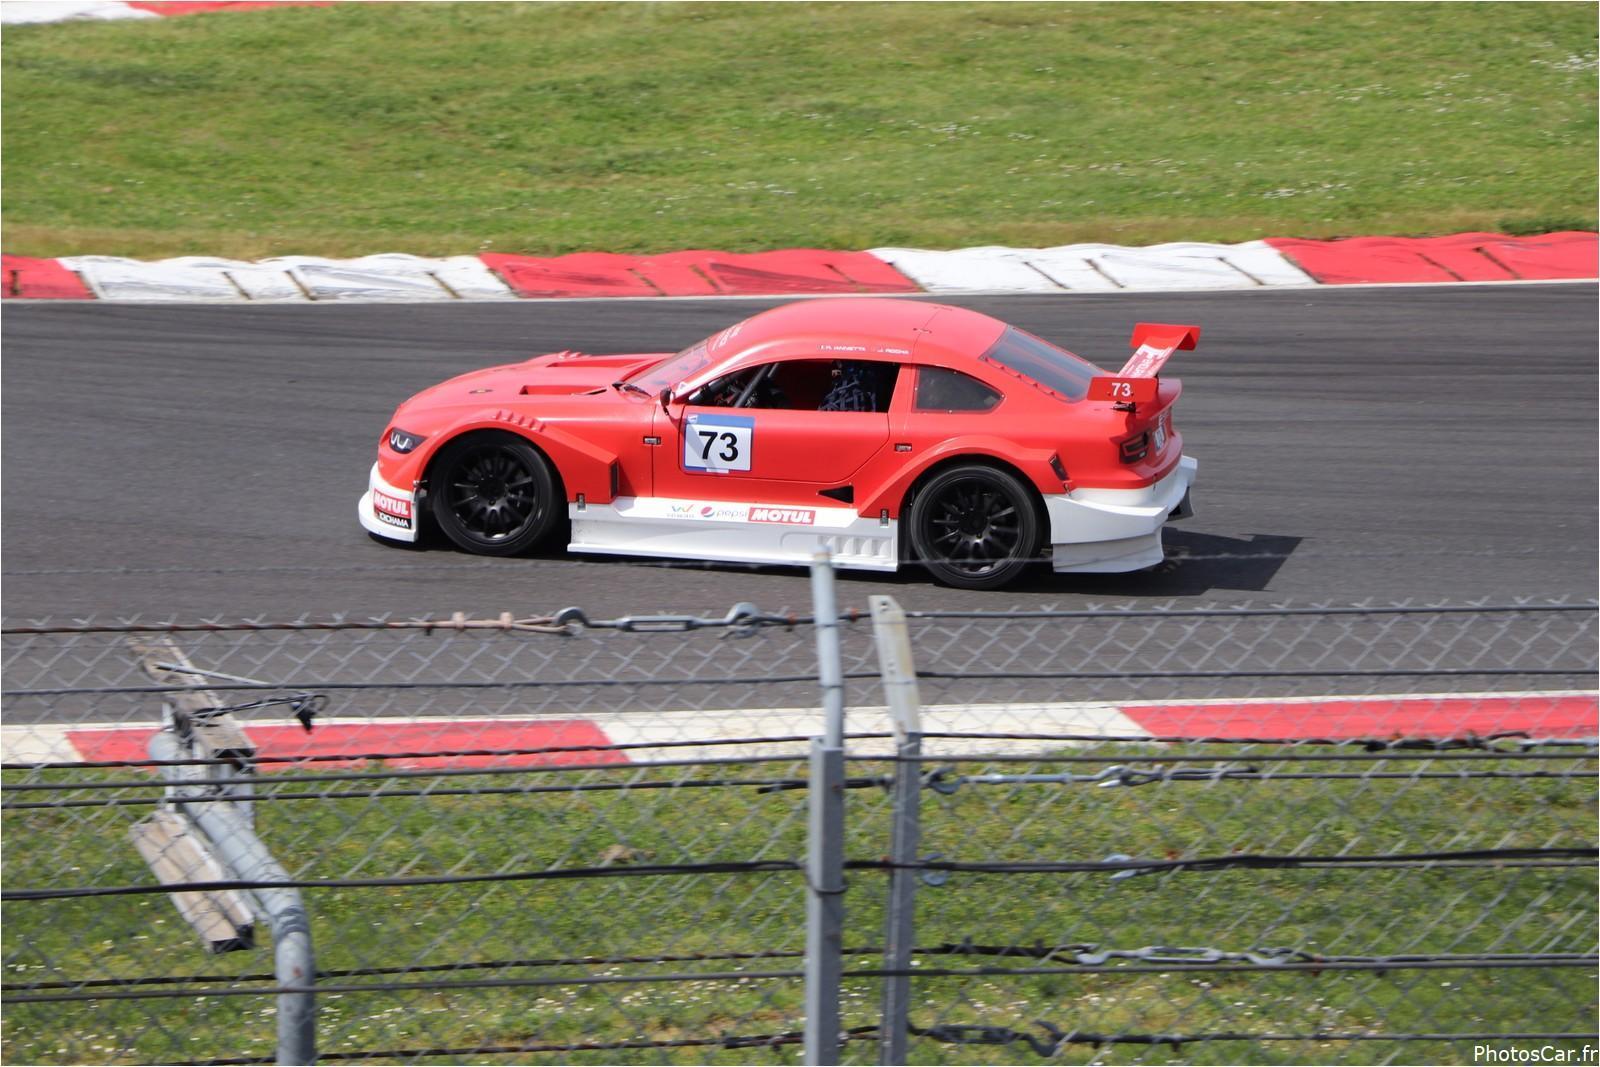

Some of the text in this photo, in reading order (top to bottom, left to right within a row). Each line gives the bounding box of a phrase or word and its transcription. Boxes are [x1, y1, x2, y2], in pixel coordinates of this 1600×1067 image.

[1111, 382, 1131, 397] 73
[699, 430, 739, 462] 73
[374, 491, 409, 515] MOTUL
[716, 509, 747, 518] pepsi
[750, 508, 812, 523] MOTUL
